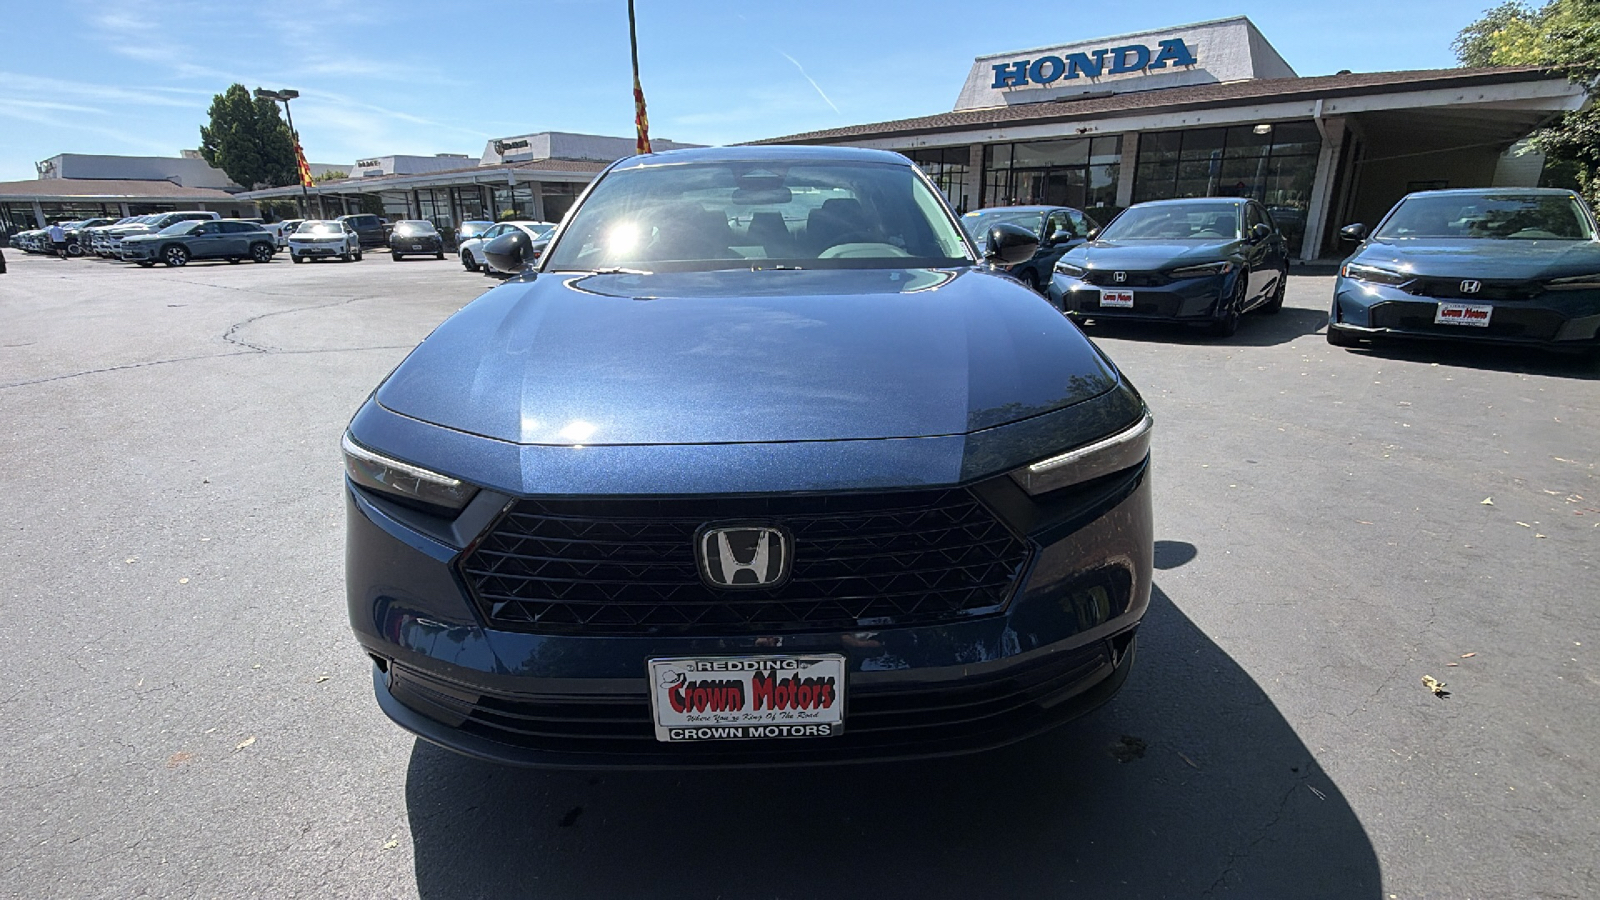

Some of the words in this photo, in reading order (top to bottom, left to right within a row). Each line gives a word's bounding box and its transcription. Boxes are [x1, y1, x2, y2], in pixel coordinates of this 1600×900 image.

[991, 37, 1198, 89] HONDA
[697, 660, 798, 671] REDDING
[668, 673, 745, 713] Crown
[752, 671, 836, 711] Motors
[742, 713, 762, 721] King
[765, 713, 776, 721] Of
[670, 727, 743, 739] CROWN
[748, 725, 831, 738] MOTORS
